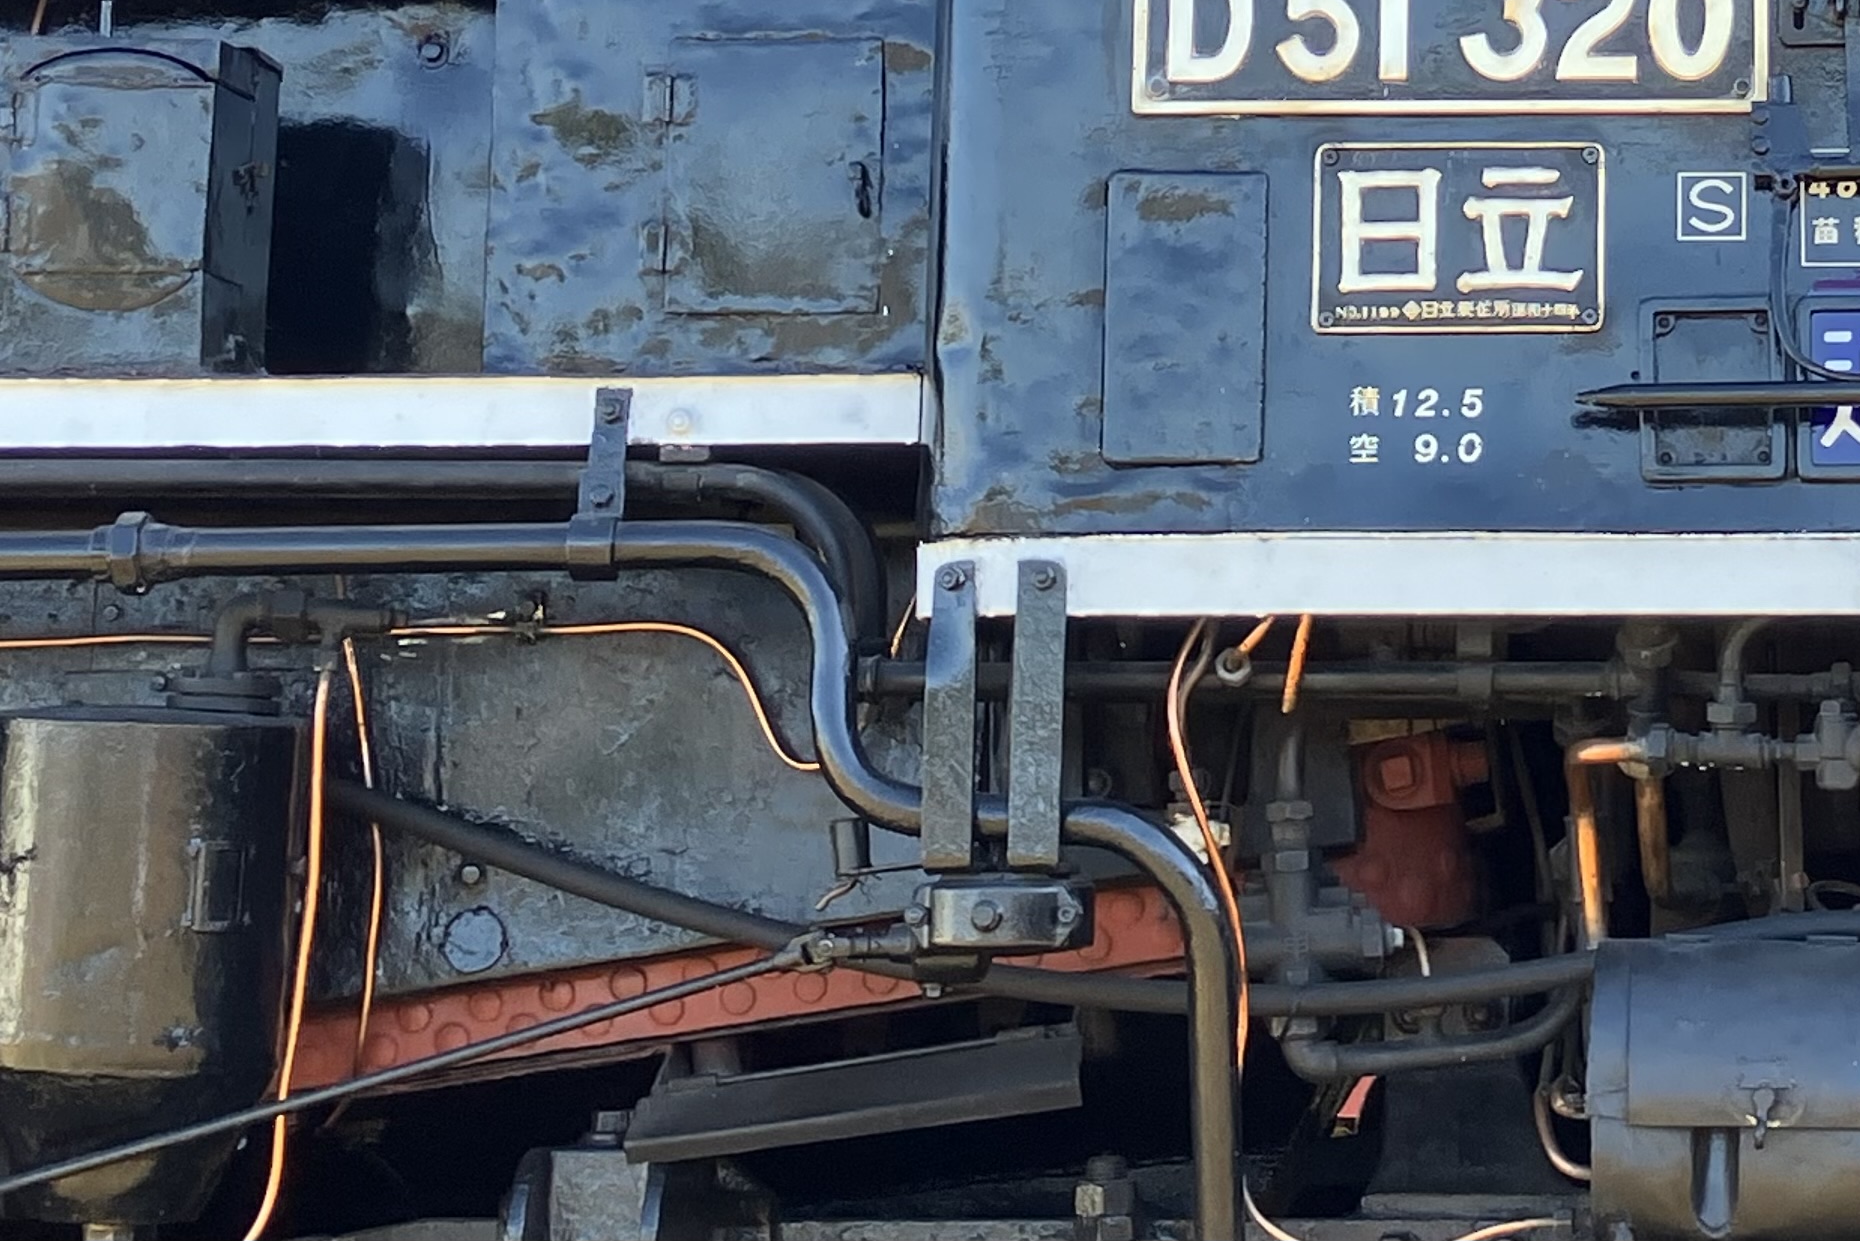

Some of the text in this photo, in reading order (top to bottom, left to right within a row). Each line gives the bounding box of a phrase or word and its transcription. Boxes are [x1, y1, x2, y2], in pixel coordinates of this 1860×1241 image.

[1689, 179, 1735, 232] S
[1337, 167, 1584, 293] 日立
[1349, 386, 1483, 418] 積 12.5
[1349, 432, 1482, 463] 空 9.0
